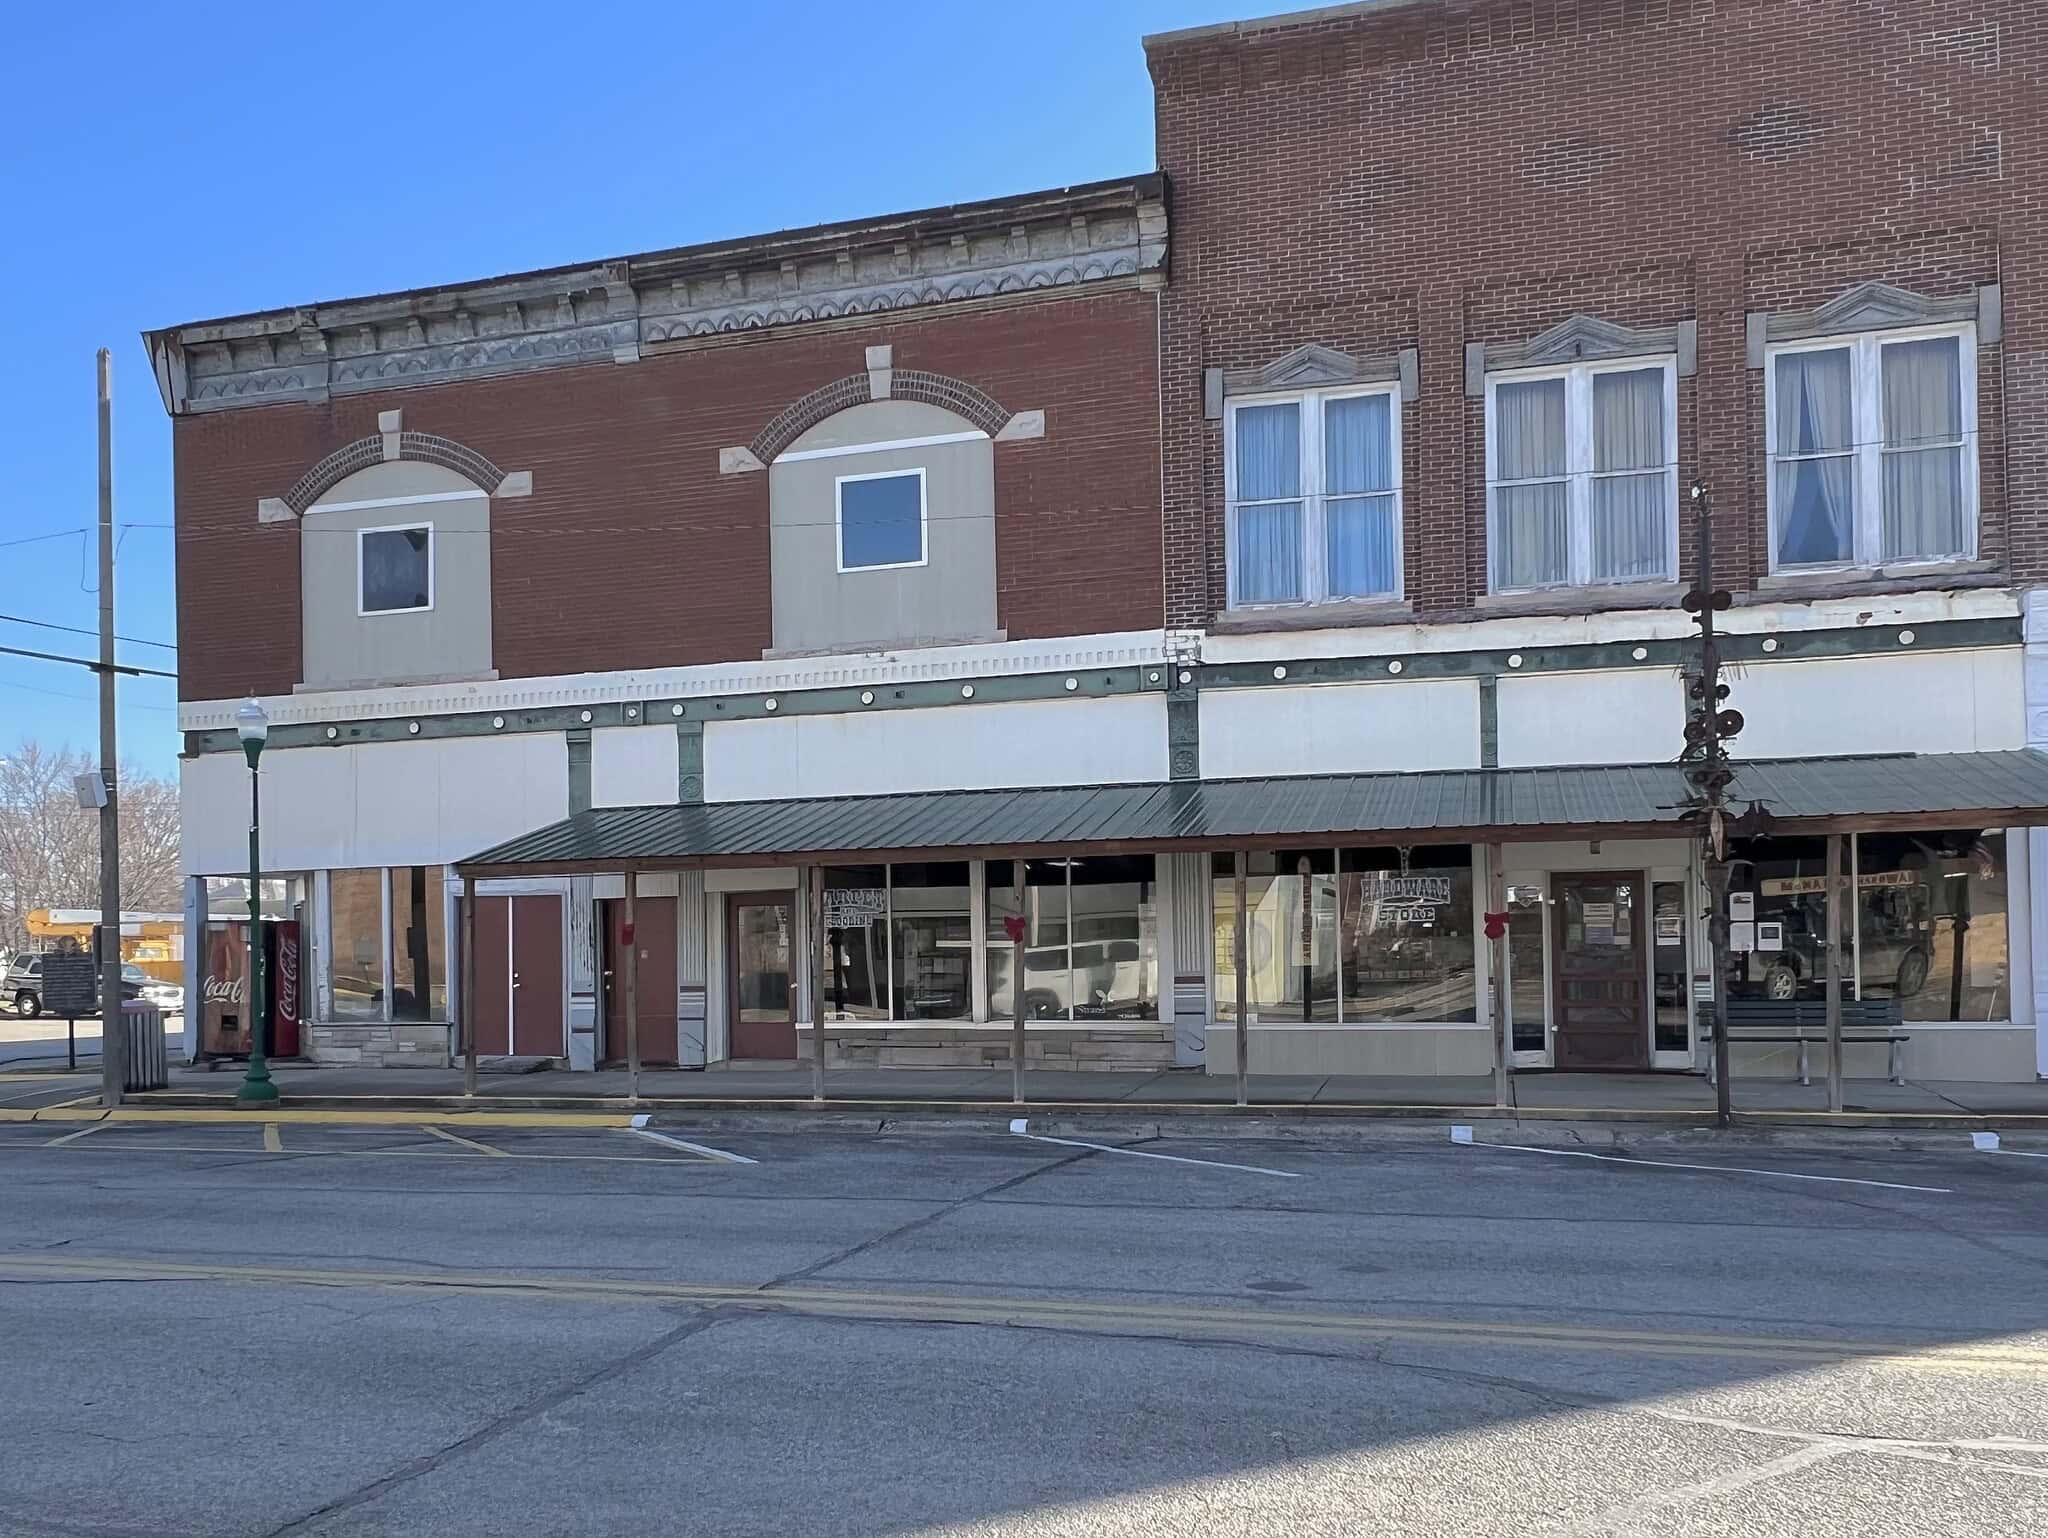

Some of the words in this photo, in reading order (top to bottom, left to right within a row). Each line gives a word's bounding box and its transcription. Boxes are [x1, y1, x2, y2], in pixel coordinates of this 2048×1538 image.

[823, 888, 885, 910] ARPET
[1361, 877, 1450, 904] HARDWARE
[1378, 907, 1436, 922] STORE
